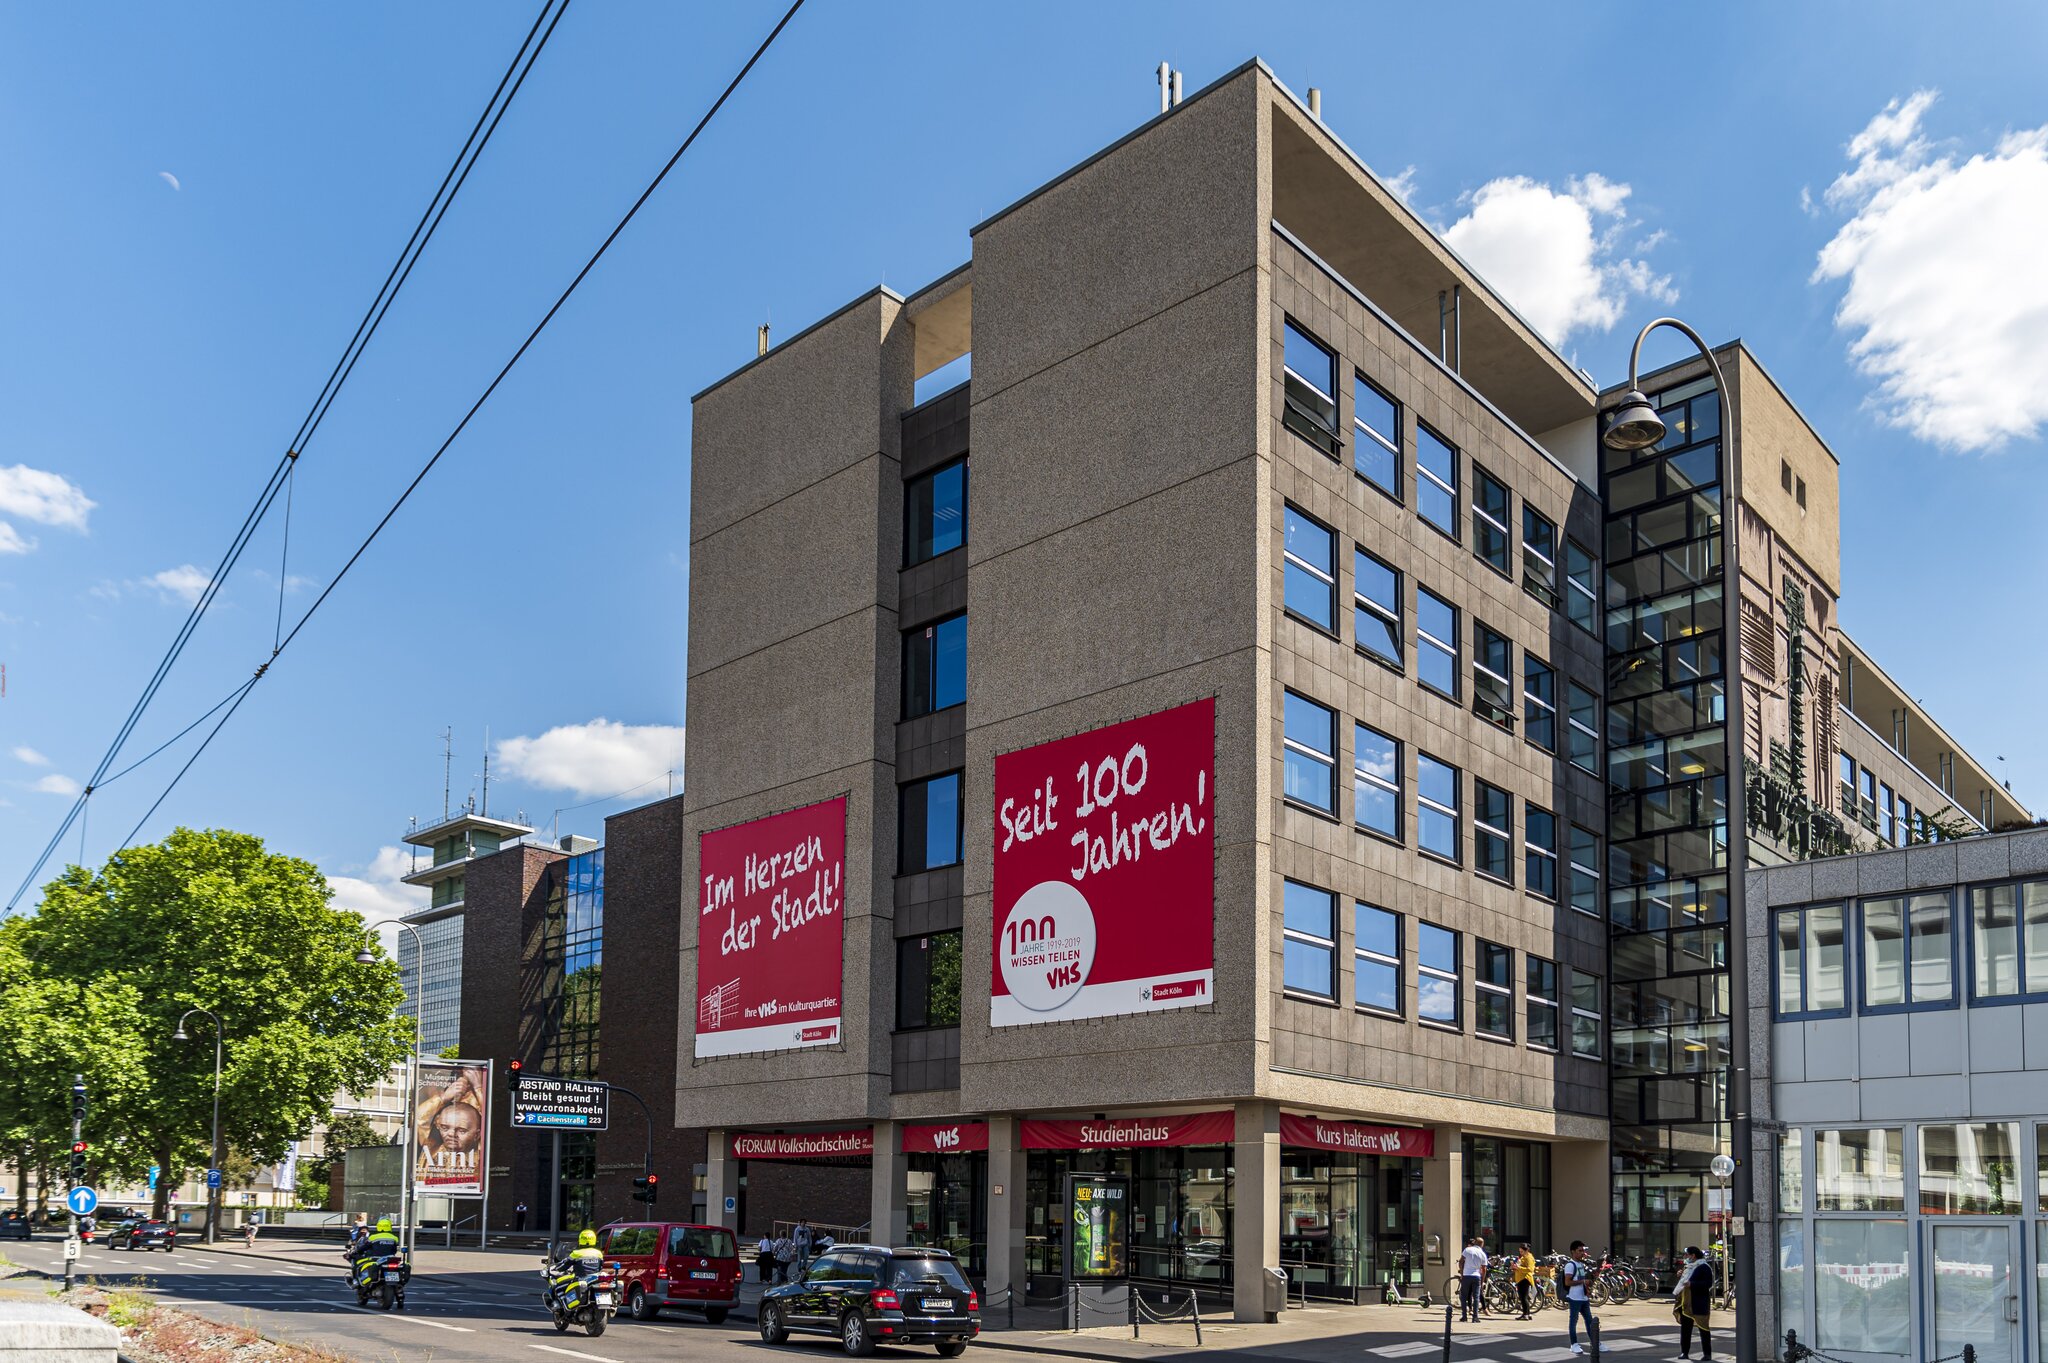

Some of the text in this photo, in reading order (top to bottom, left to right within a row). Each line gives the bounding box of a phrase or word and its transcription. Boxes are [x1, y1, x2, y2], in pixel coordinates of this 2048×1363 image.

[1001, 742, 1148, 852] Seit 100
[1071, 769, 1205, 880] Jahren!
[702, 835, 824, 915] Im Herzen
[721, 861, 840, 955] der Stadt!
[1020, 937, 1081, 954] JAHRE 1919-2019
[1011, 949, 1080, 967] WISSEN TEILEN
[1047, 961, 1081, 990] VHS
[1154, 986, 1183, 997] Stadt Köln
[744, 997, 838, 1019] Ihre VHS im Kulturquartier.
[424, 1073, 457, 1082] Museum
[519, 1080, 561, 1091] ABSTAND
[523, 1091, 552, 1101] Bleibt
[557, 1095, 591, 1104] gesund
[516, 1103, 603, 1115] www.corona.koeln
[588, 1116, 602, 1124] 223
[934, 1127, 960, 1149] VHS
[1080, 1122, 1169, 1143] Studienhaus
[1316, 1125, 1401, 1153] Kurs halten: VHS
[741, 1137, 776, 1154] FORUM
[778, 1133, 861, 1154] Volkshochschule
[416, 1145, 476, 1168] Arnt
[1077, 1187, 1123, 1199] NEU: AXE WILD
[69, 1243, 76, 1256] 5
